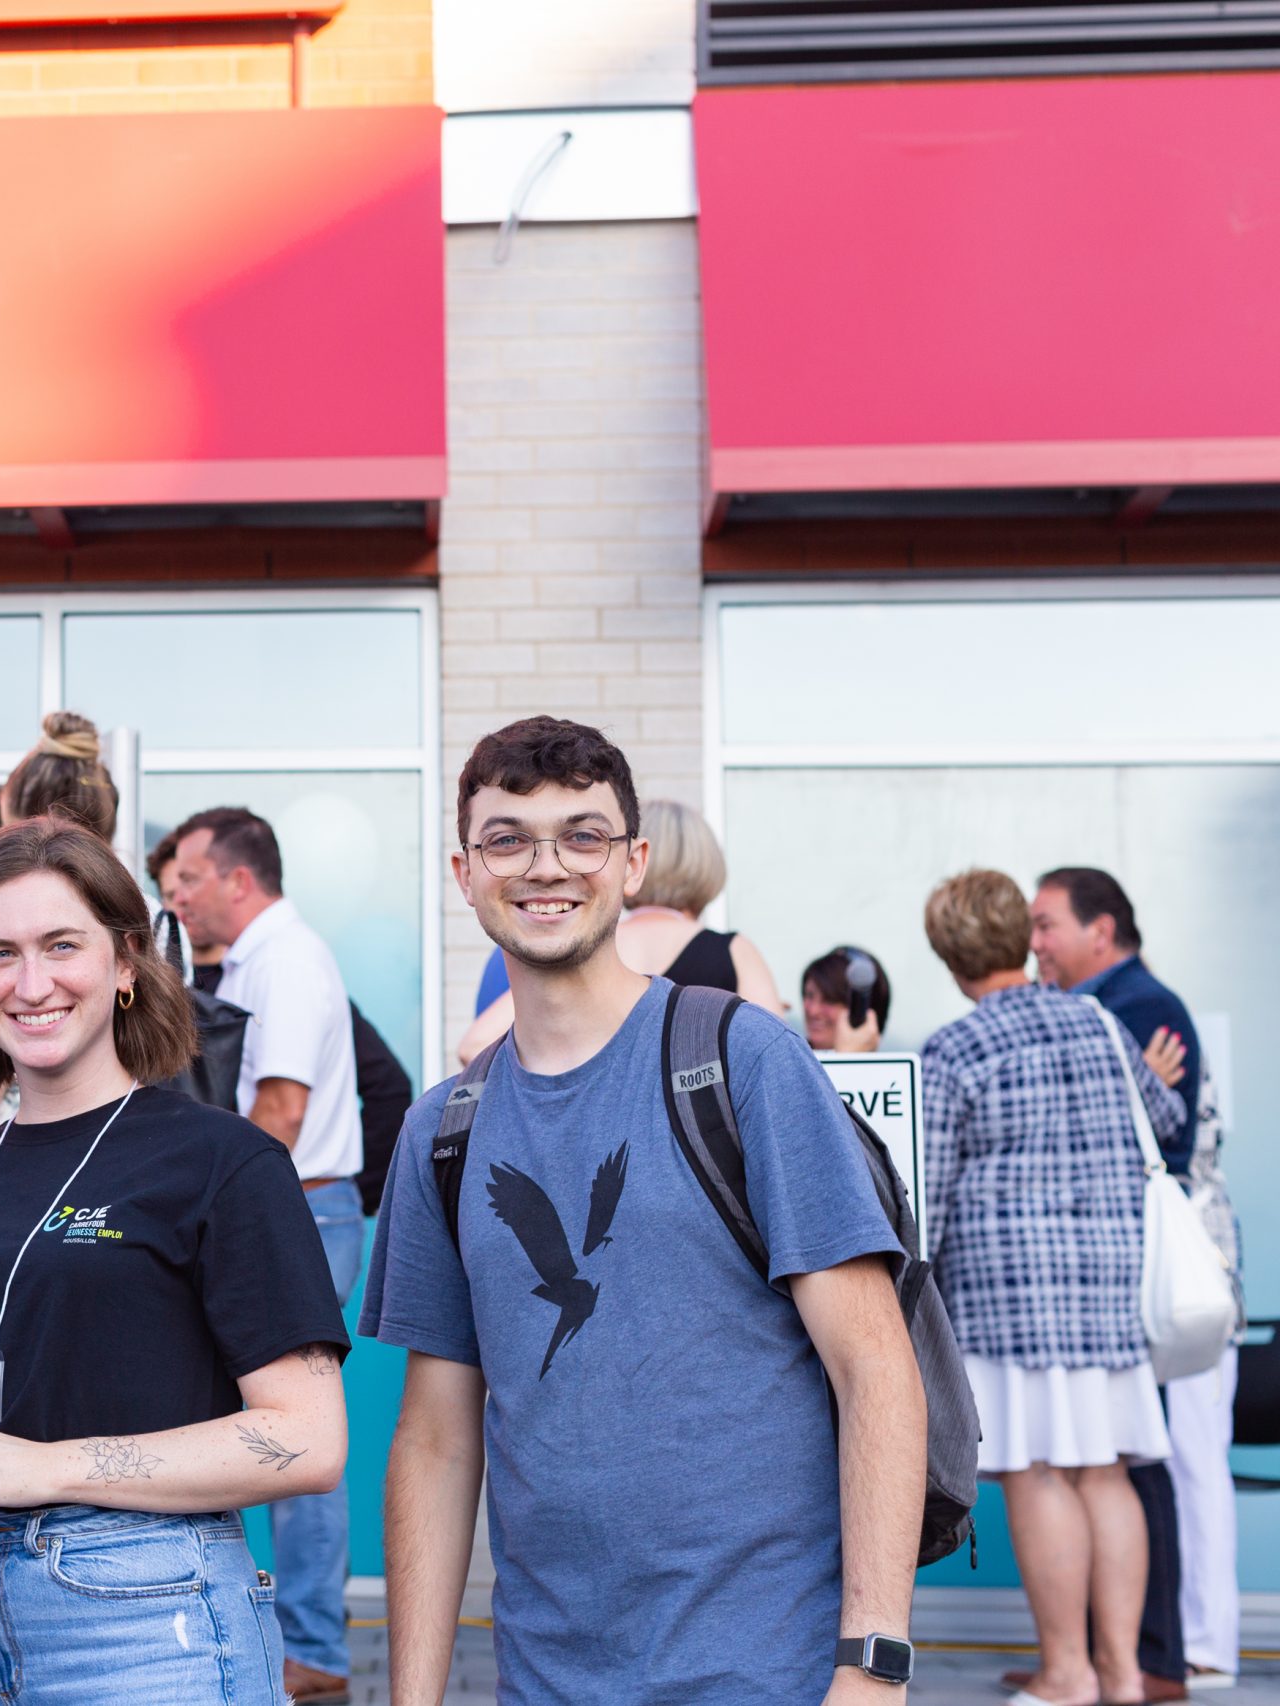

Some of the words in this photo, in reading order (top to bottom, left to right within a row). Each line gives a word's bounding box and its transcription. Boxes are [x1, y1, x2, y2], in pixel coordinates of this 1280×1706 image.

[679, 1066, 715, 1088] ROOTS
[74, 1205, 112, 1221] CJE
[69, 1220, 105, 1229] CARREFOUR
[65, 1229, 97, 1237] JEUNESSE
[97, 1229, 123, 1239] EMPLOI
